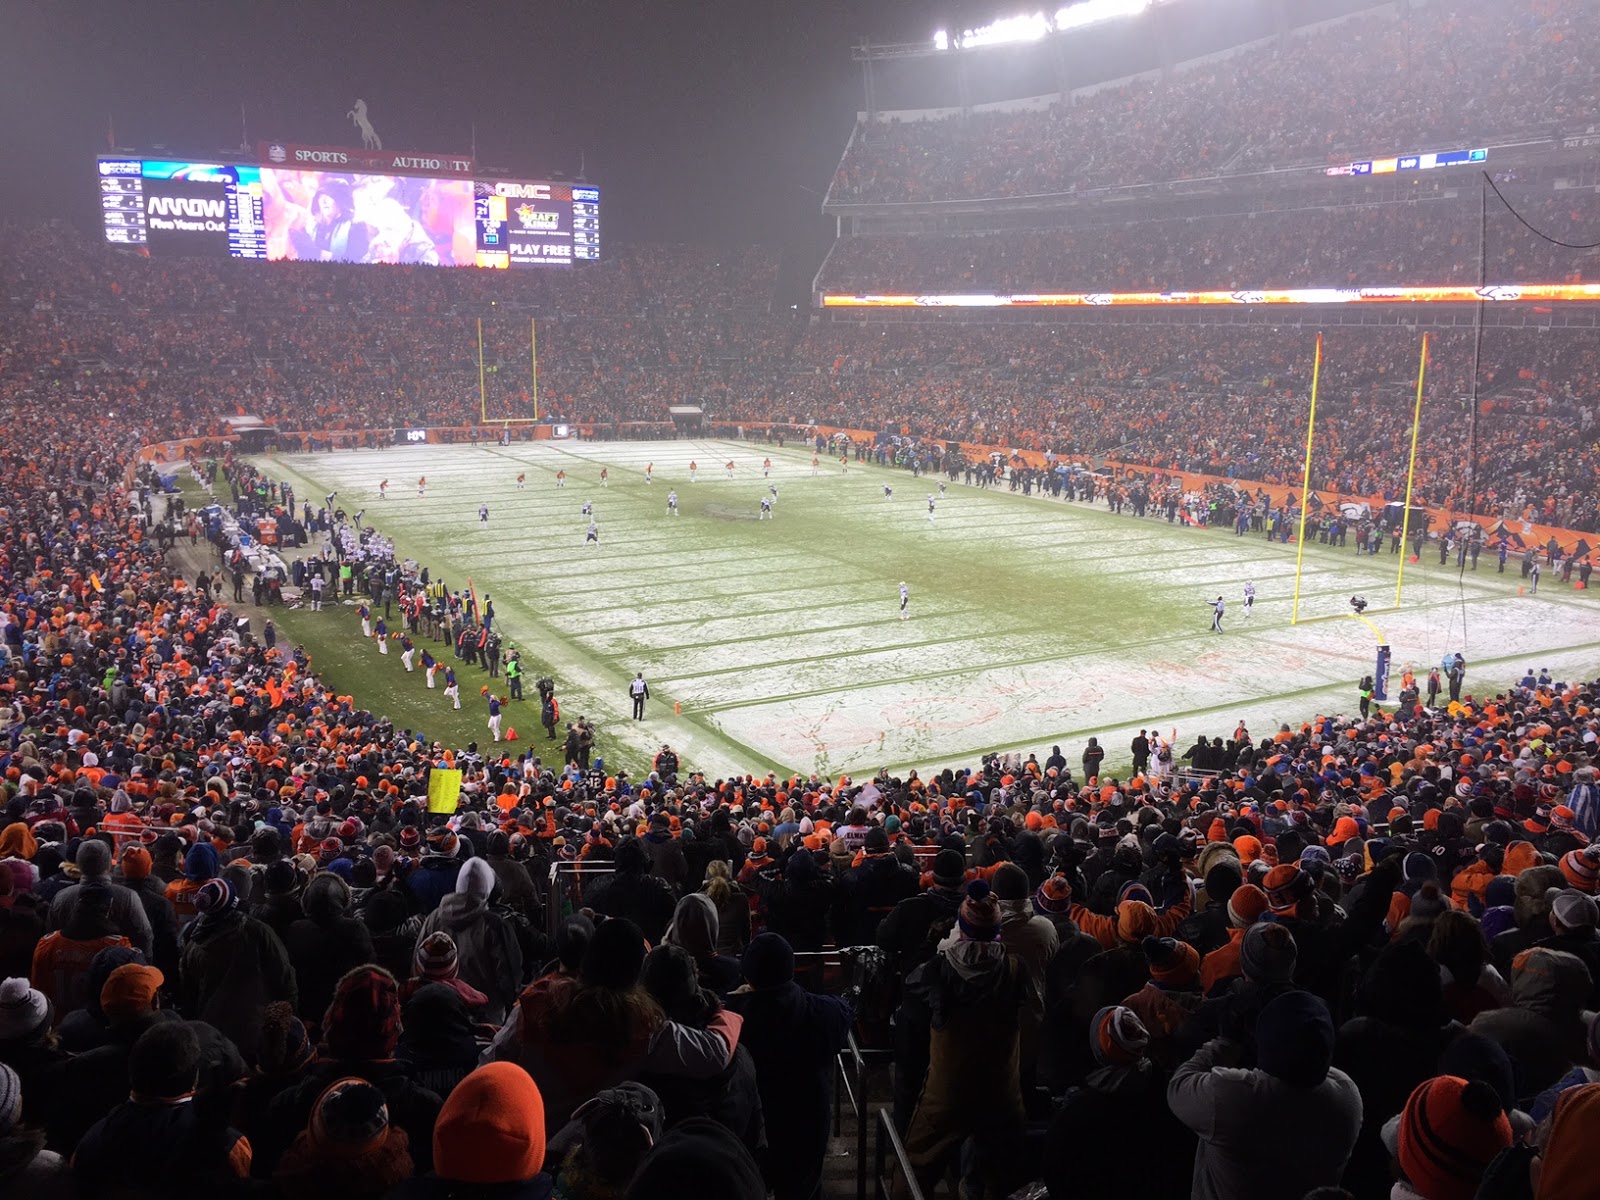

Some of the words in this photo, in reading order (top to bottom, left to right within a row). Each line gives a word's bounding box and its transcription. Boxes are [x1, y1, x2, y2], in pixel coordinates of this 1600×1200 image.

[295, 150, 348, 164] SPORTS
[392, 156, 471, 172] AUTHORITY
[495, 182, 551, 200] GMC
[147, 196, 226, 218] ARROW
[149, 217, 174, 230] Five
[173, 218, 205, 231] Years
[205, 220, 226, 232] Out
[509, 243, 541, 256] PLAY
[542, 244, 571, 257] FREE
[407, 430, 425, 441] 1:09
[442, 428, 530, 442] BRONCO
[589, 777, 602, 789] 12
